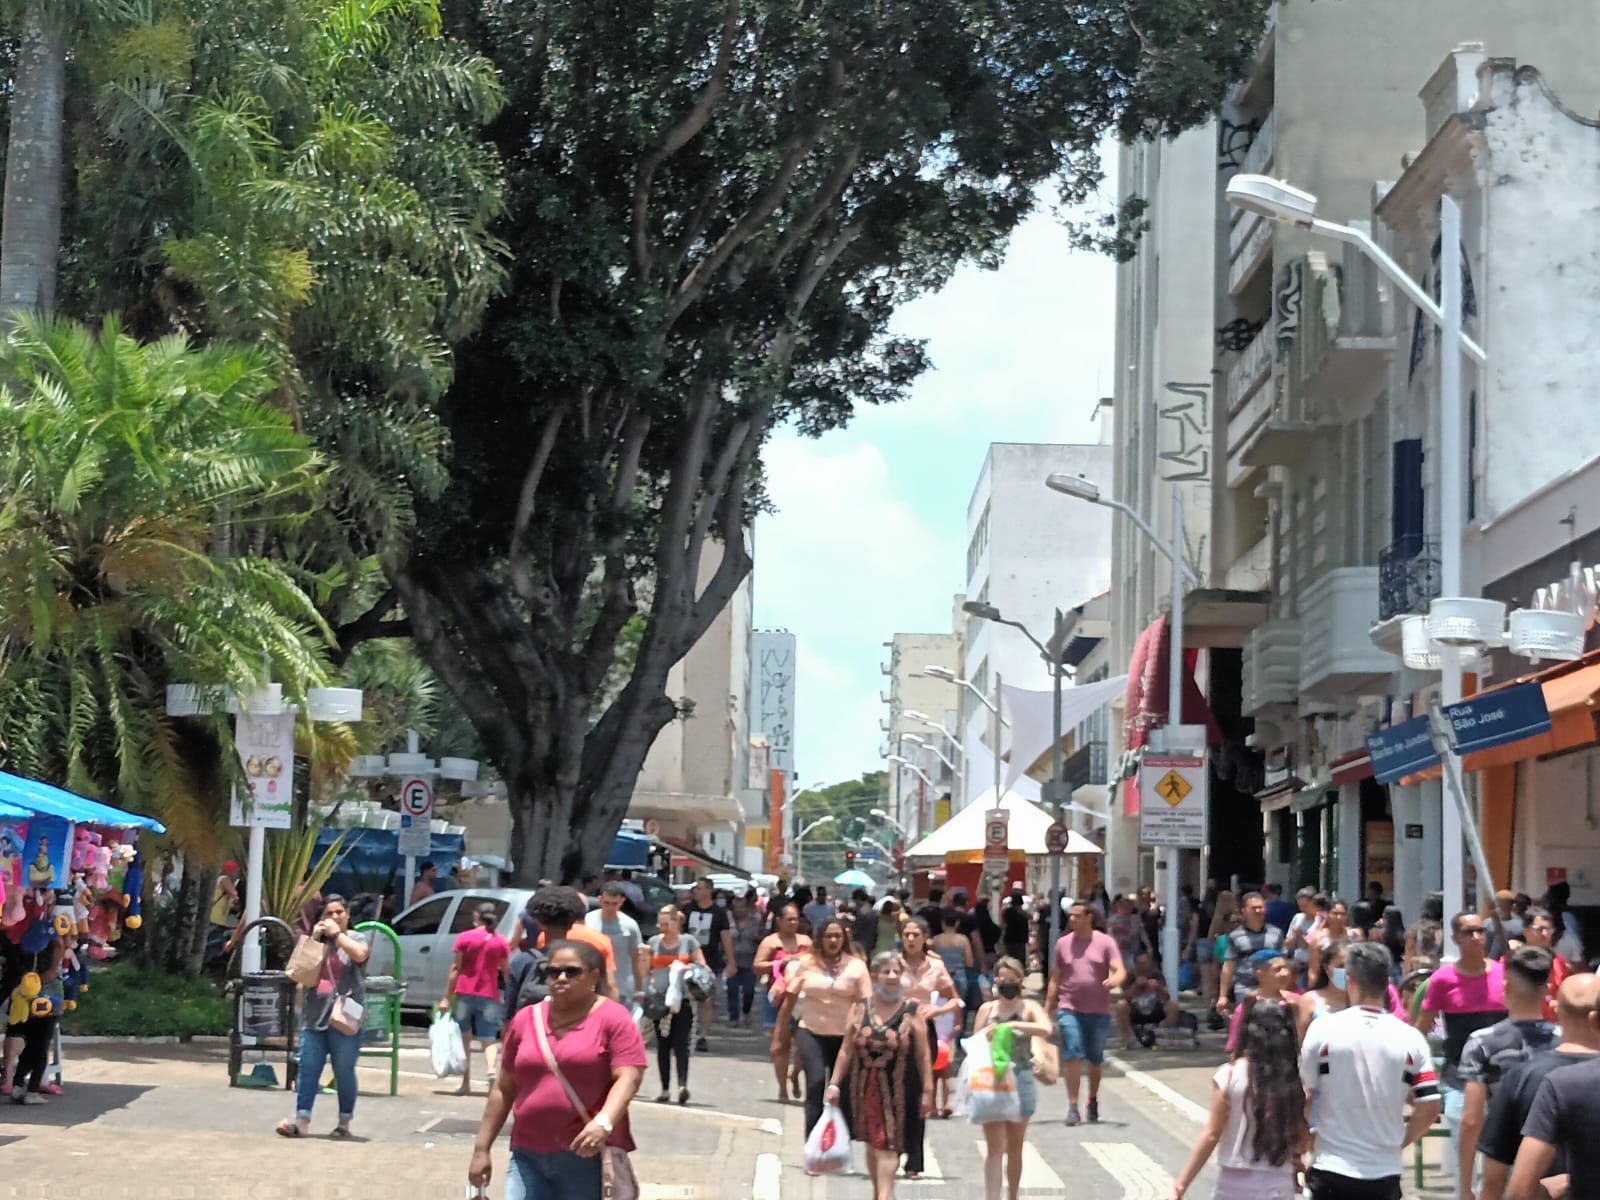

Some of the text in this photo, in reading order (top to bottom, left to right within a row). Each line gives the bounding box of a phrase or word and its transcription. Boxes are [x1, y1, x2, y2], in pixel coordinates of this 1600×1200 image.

[1449, 705, 1472, 718] Rua
[1453, 709, 1504, 730] São José
[411, 788, 424, 809] E
[991, 826, 1001, 839] E
